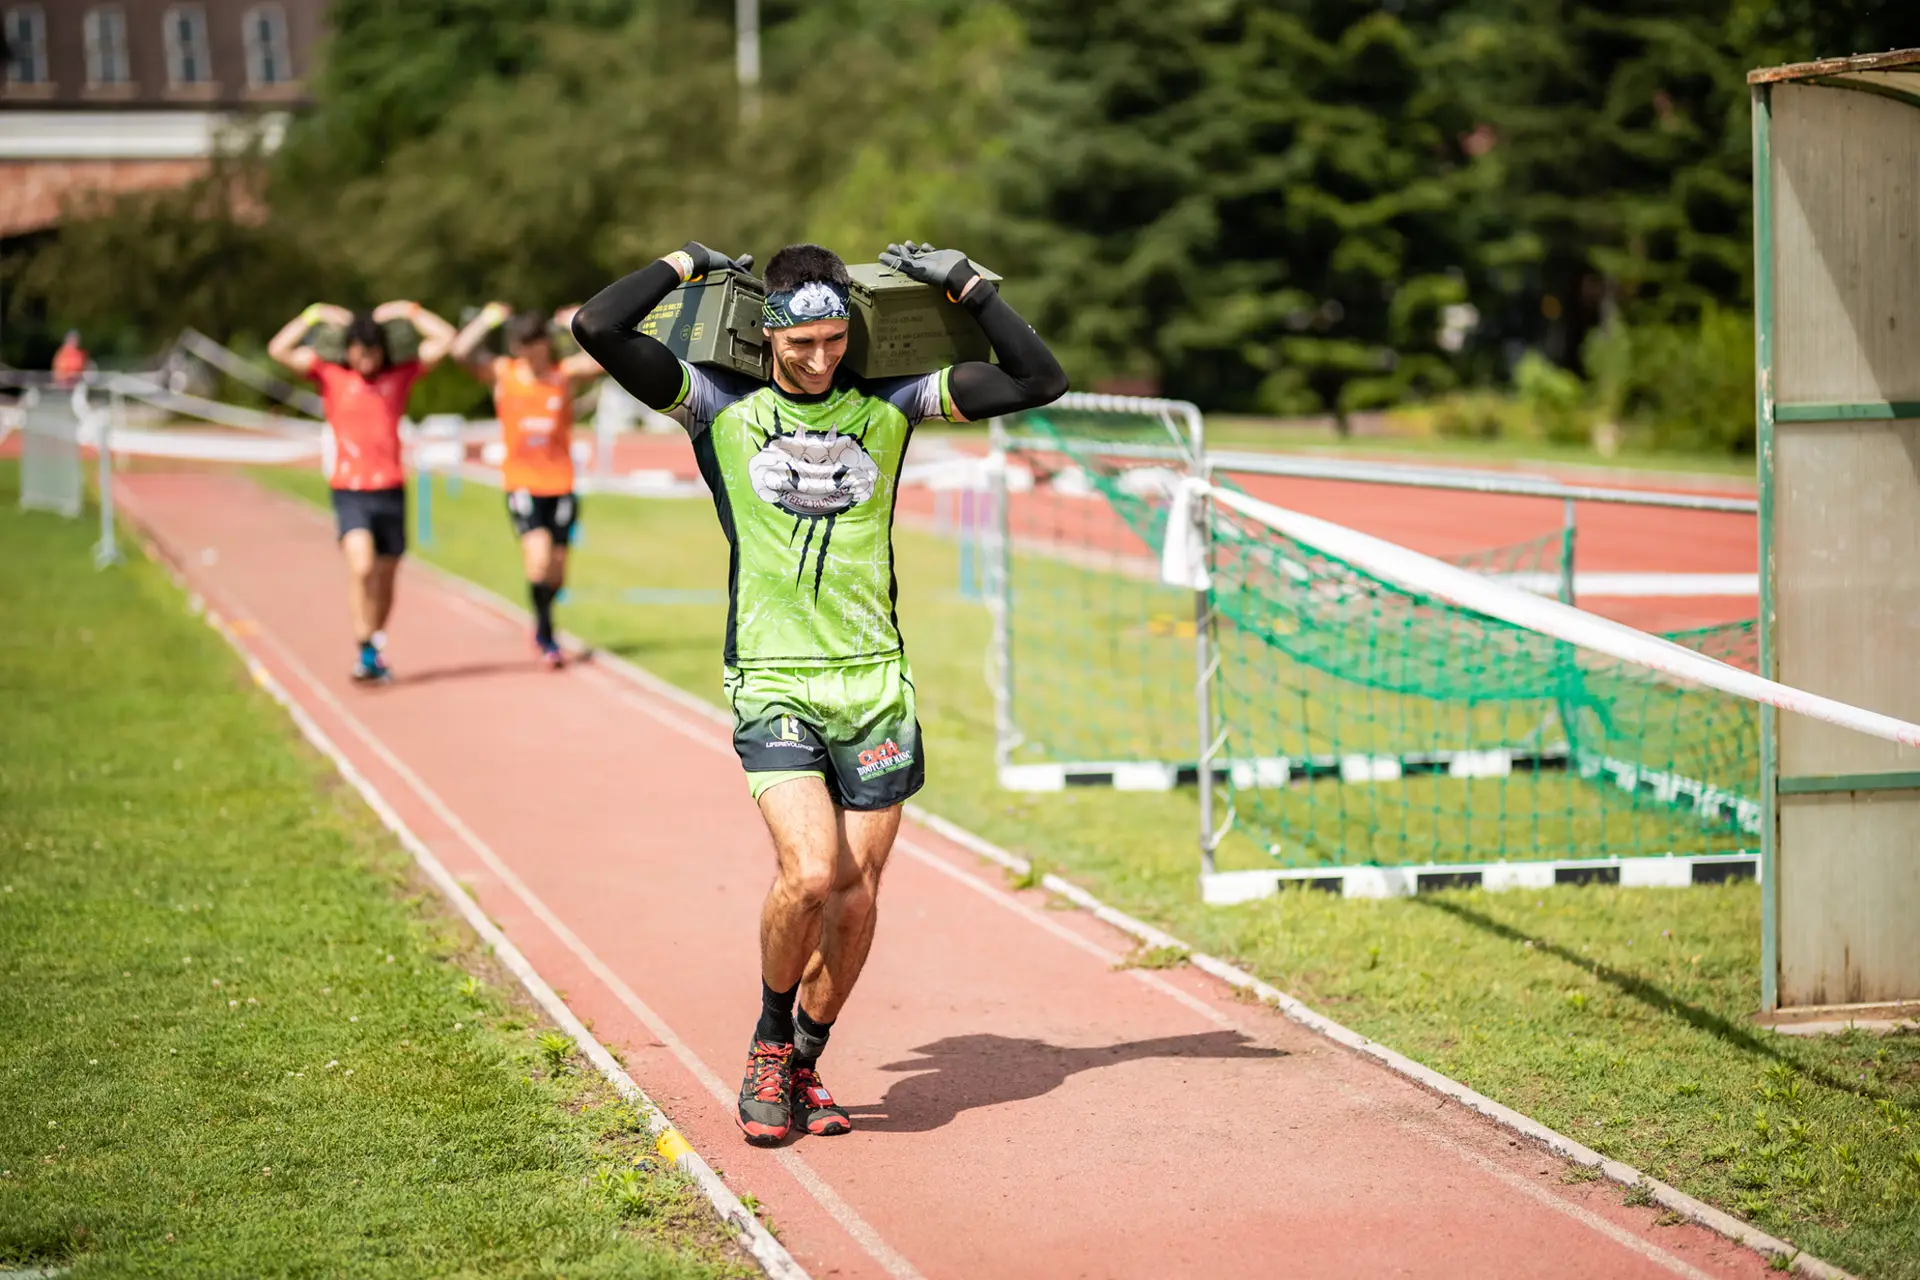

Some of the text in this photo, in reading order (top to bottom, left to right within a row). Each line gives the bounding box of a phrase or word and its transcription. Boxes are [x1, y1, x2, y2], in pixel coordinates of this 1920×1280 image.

[781, 490, 809, 508] WERE
[858, 740, 901, 766] OCR
[857, 758, 893, 776] BOOTCAMP
